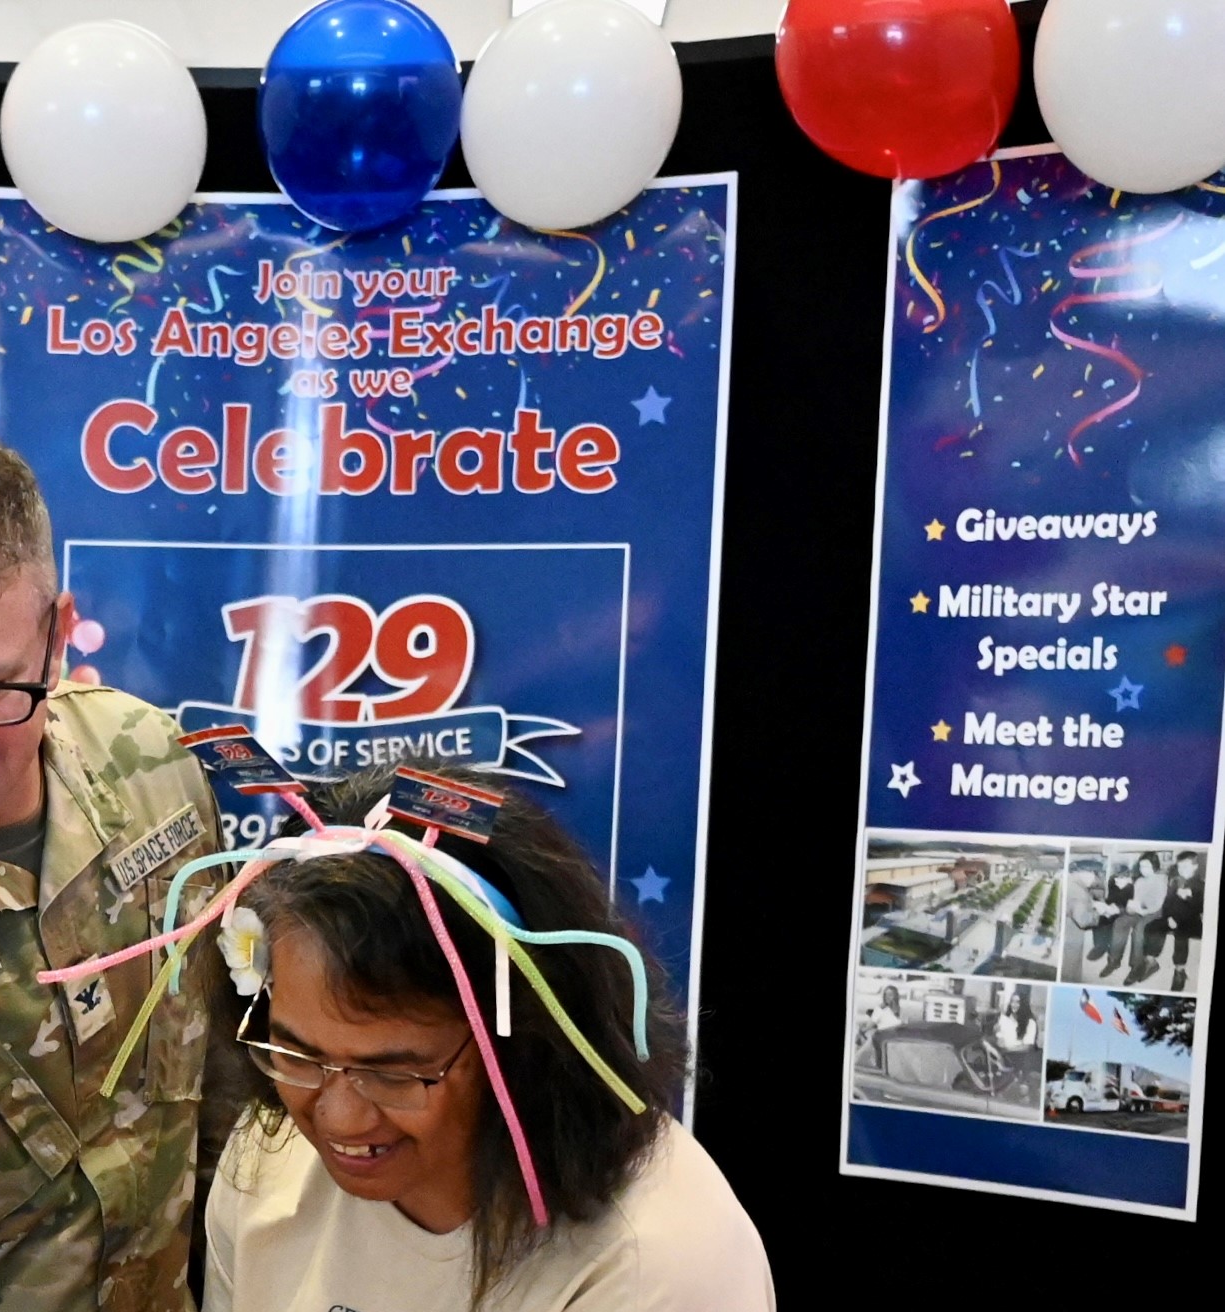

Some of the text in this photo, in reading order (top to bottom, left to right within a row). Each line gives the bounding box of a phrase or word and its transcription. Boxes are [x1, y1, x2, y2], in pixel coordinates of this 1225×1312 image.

[255, 260, 455, 304] Join your
[47, 304, 664, 366] Los Angeles Exchange
[291, 369, 414, 398] as we
[81, 399, 620, 495] Celebrate
[956, 507, 1158, 544] Giveaways
[938, 582, 1168, 623] Military Star
[222, 594, 475, 723] 129
[977, 635, 1118, 676] Specials
[307, 740, 349, 767] OF
[355, 728, 472, 766] SERVICE
[963, 711, 1125, 748] Meet the
[950, 762, 1130, 805] Managers
[132, 832, 171, 875] SPACE
[163, 811, 199, 851] FORCE
